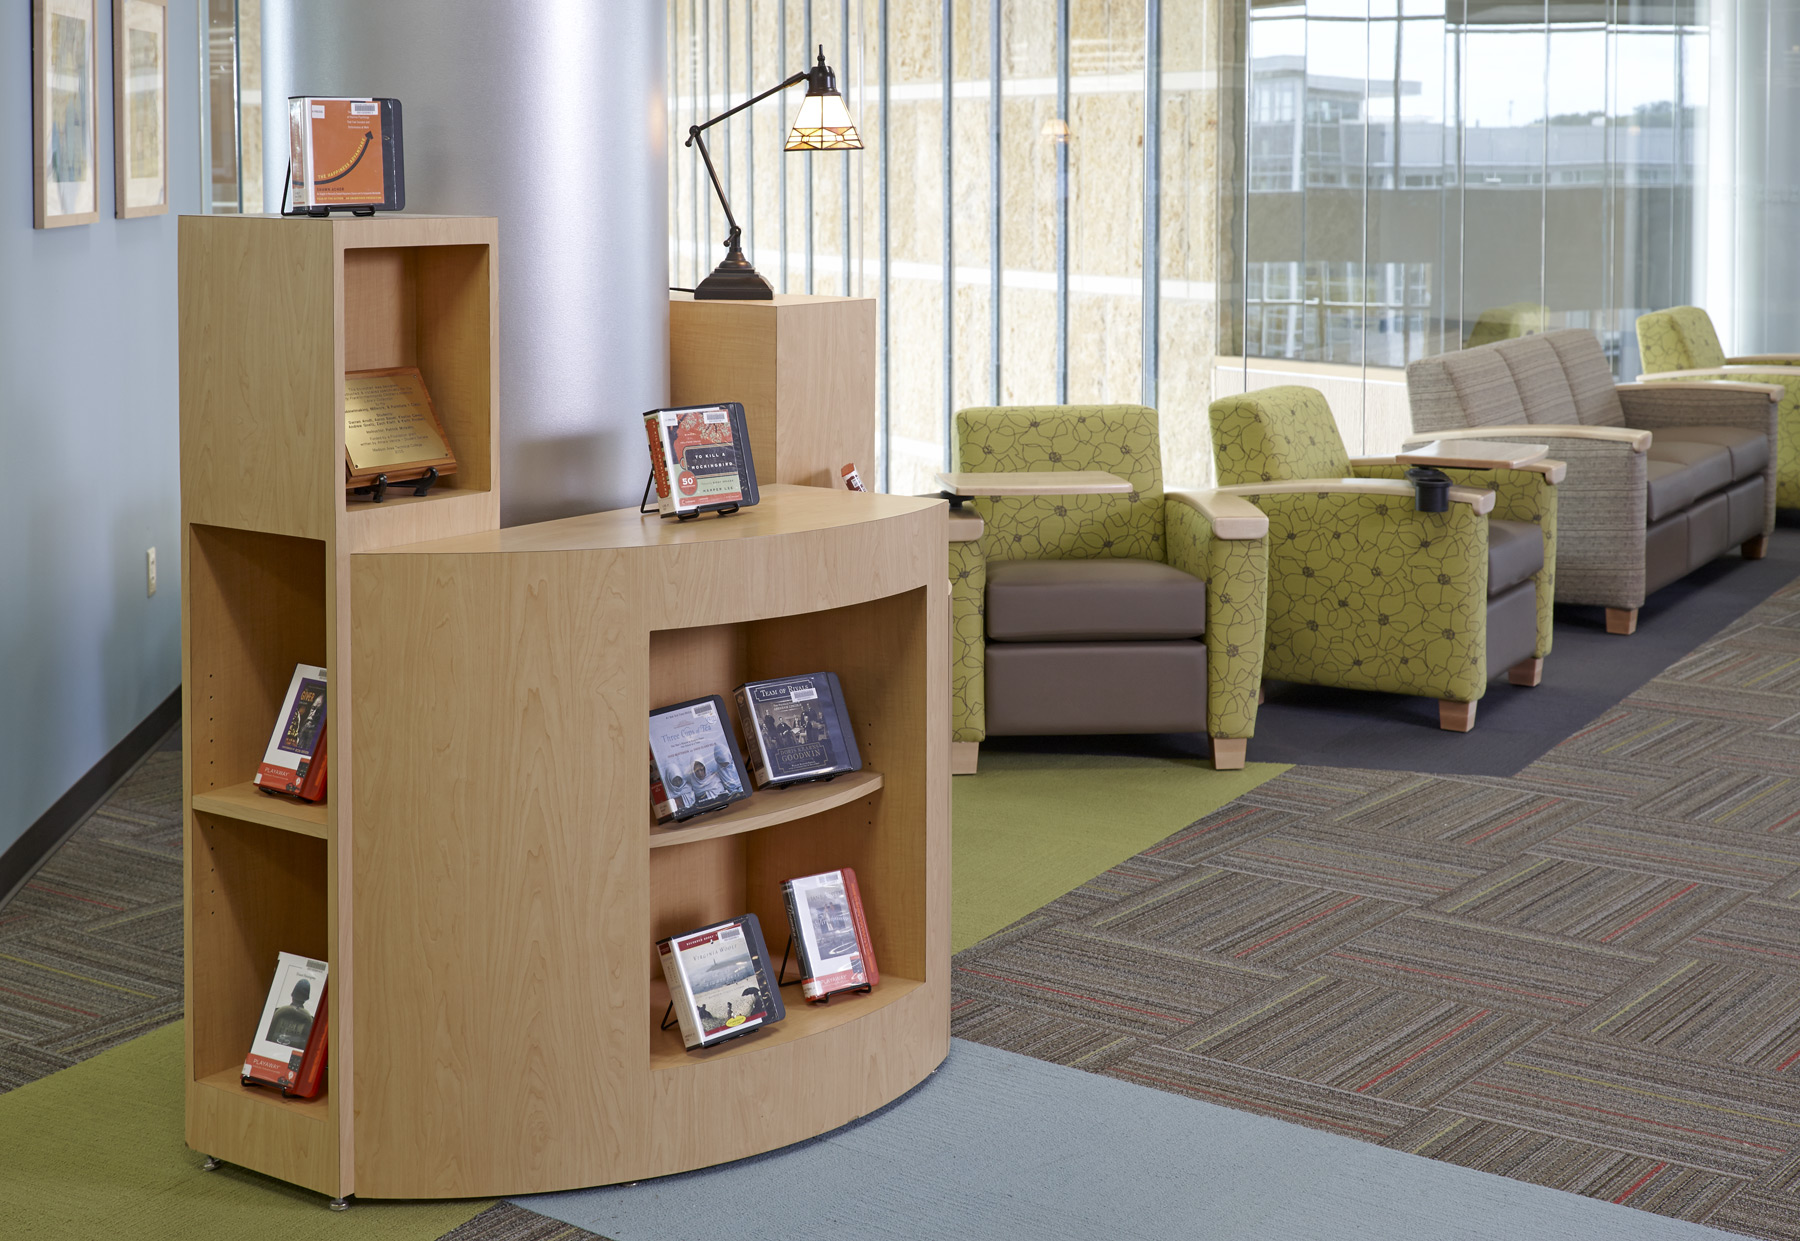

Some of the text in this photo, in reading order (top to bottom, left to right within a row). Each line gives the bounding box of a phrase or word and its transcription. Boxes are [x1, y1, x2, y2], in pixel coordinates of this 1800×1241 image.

[328, 163, 350, 178] HAPPINESS
[350, 138, 366, 164] ADVANTAGE
[691, 462, 733, 470] MOCKINGBIRD
[300, 690, 315, 702] GIVER
[661, 734, 680, 743] Three
[681, 726, 695, 738] Cups
[782, 749, 820, 762] GOODWIN
[264, 767, 289, 776] PLAYAWAY
[693, 944, 737, 961] VIRGINIA WOOLF
[253, 1058, 279, 1069] PLAYAWAY
